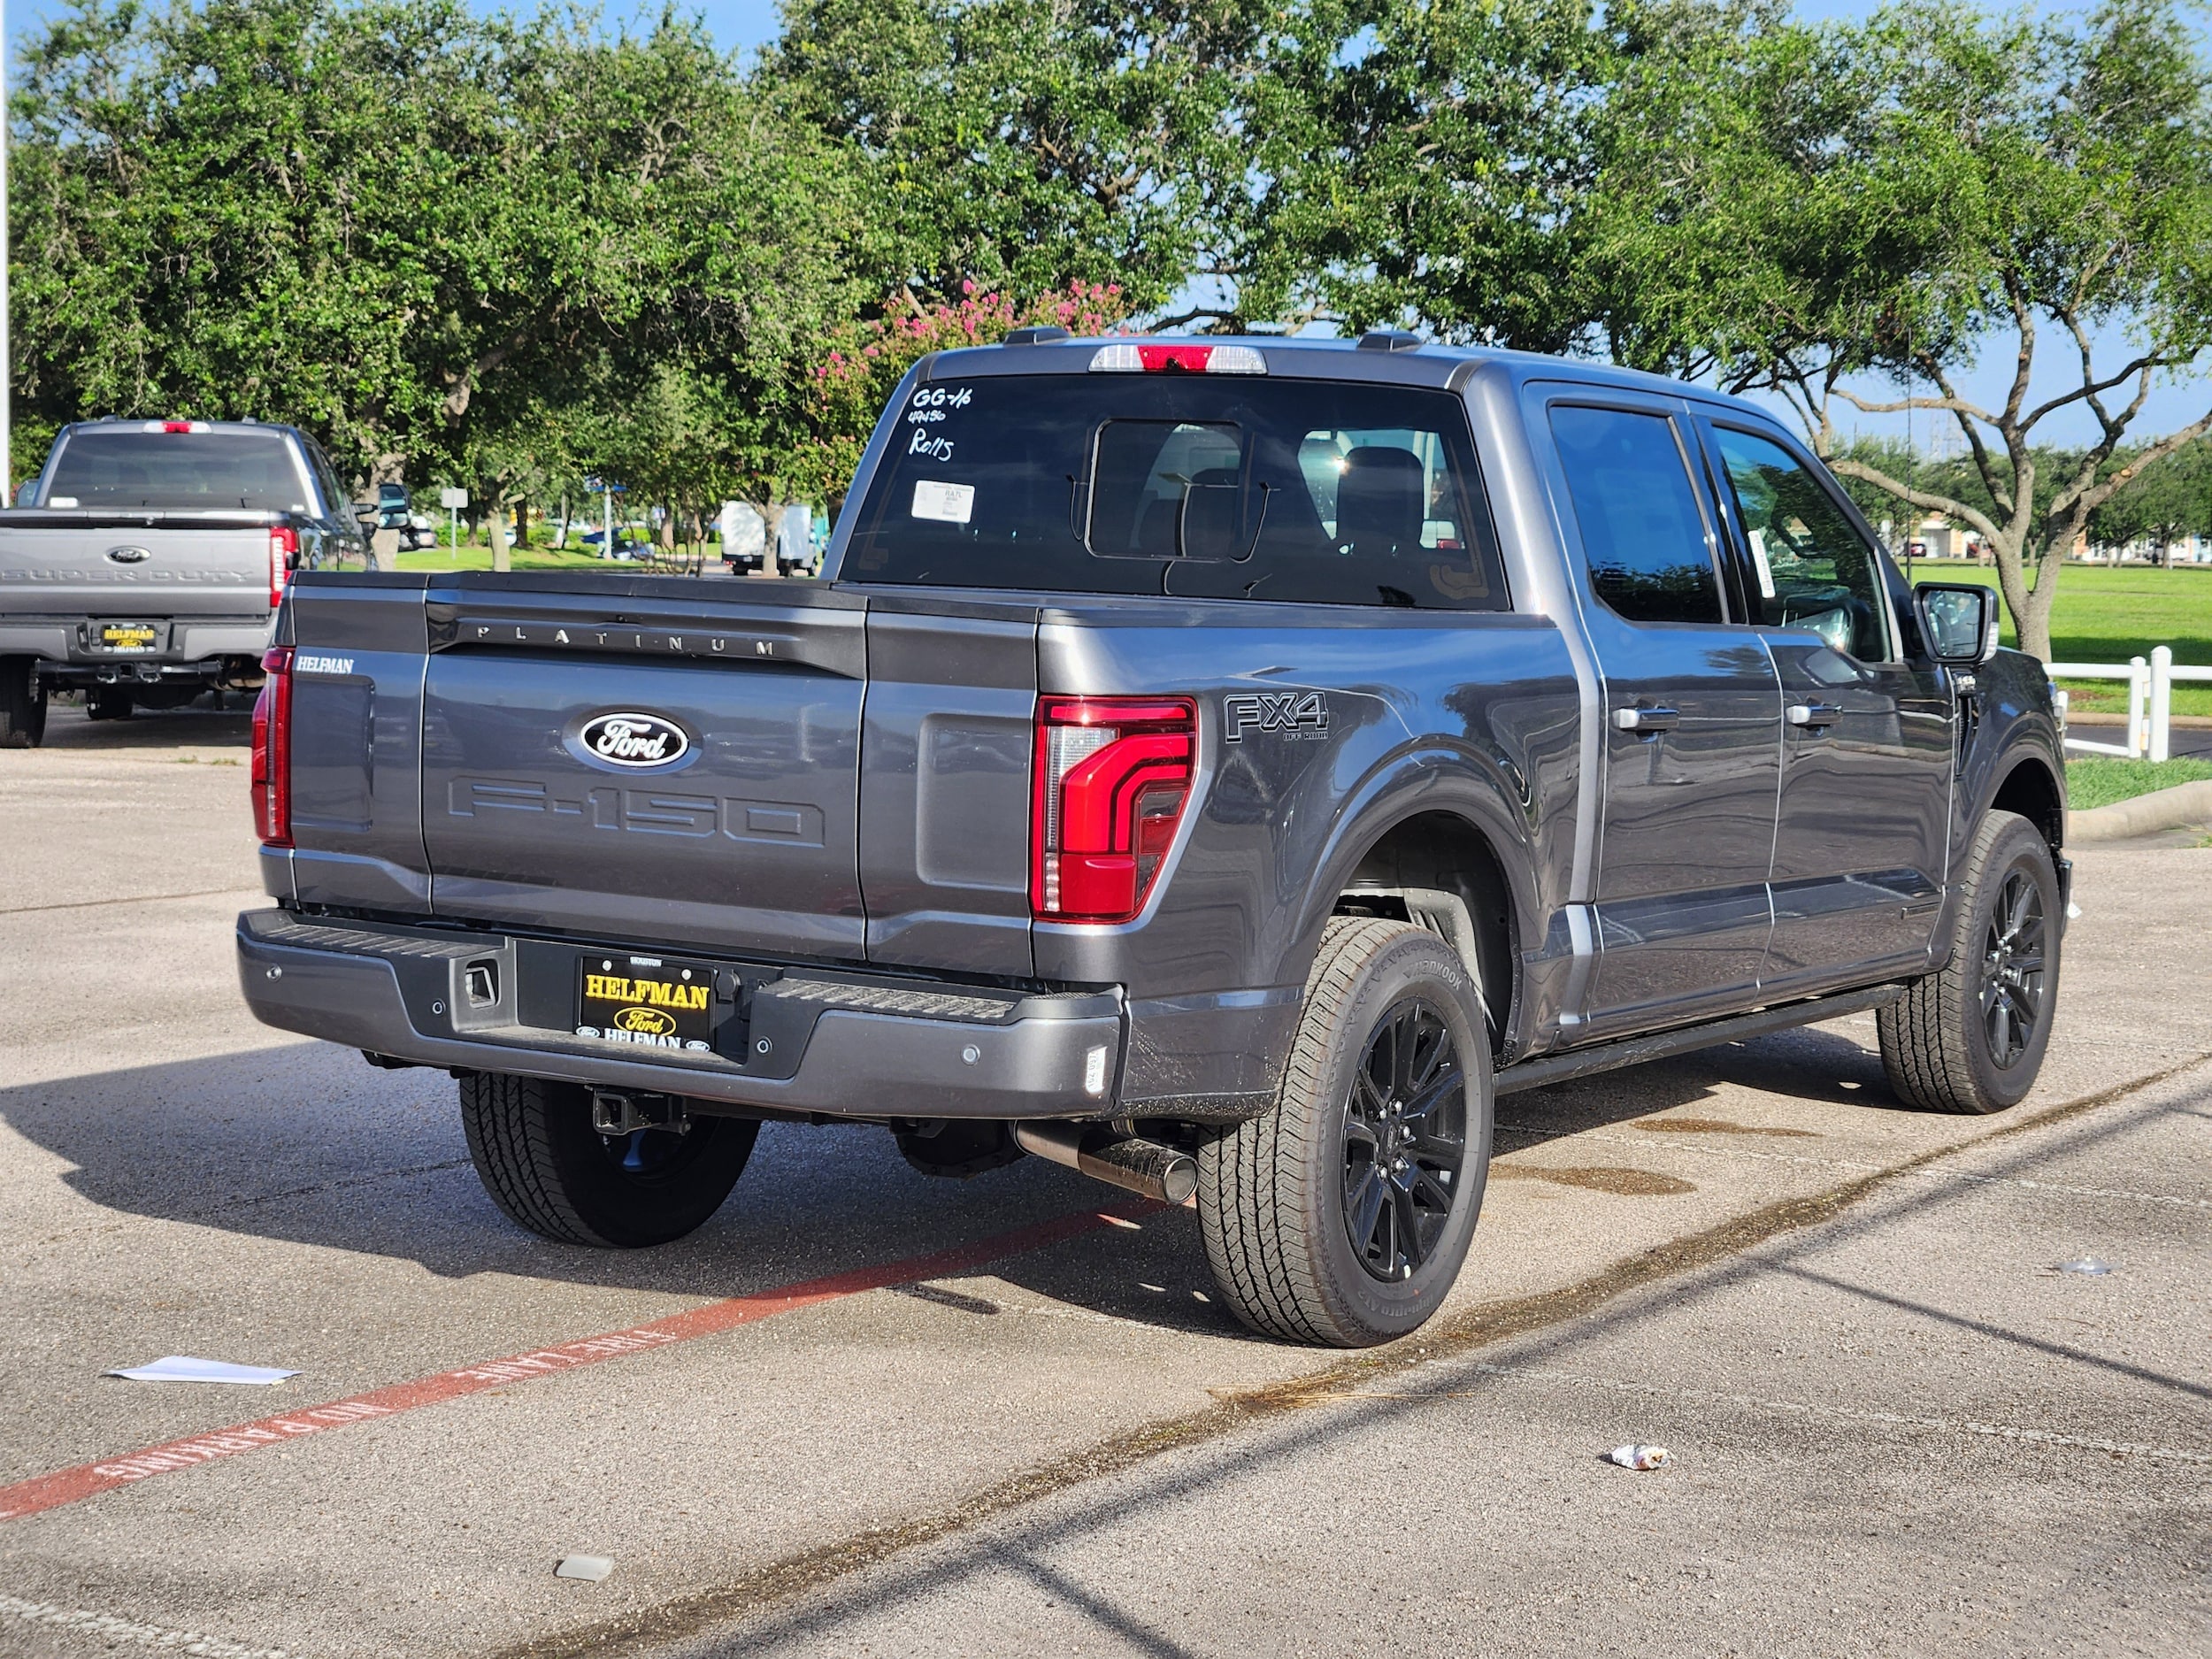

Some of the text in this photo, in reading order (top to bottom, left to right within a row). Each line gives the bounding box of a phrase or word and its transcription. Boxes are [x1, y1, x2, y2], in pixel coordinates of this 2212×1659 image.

[2, 568, 254, 582] SUPER DUTY
[478, 626, 774, 656] PLATINUM
[296, 655, 354, 675] HELFMAN
[1223, 692, 1330, 744] FX4
[596, 718, 669, 760] Ford
[448, 775, 826, 849] F-150
[586, 974, 710, 1010] HELFMAN
[626, 1010, 664, 1033] Ford
[309, 1402, 395, 1422] NO
[92, 1419, 323, 1479] PARKING
